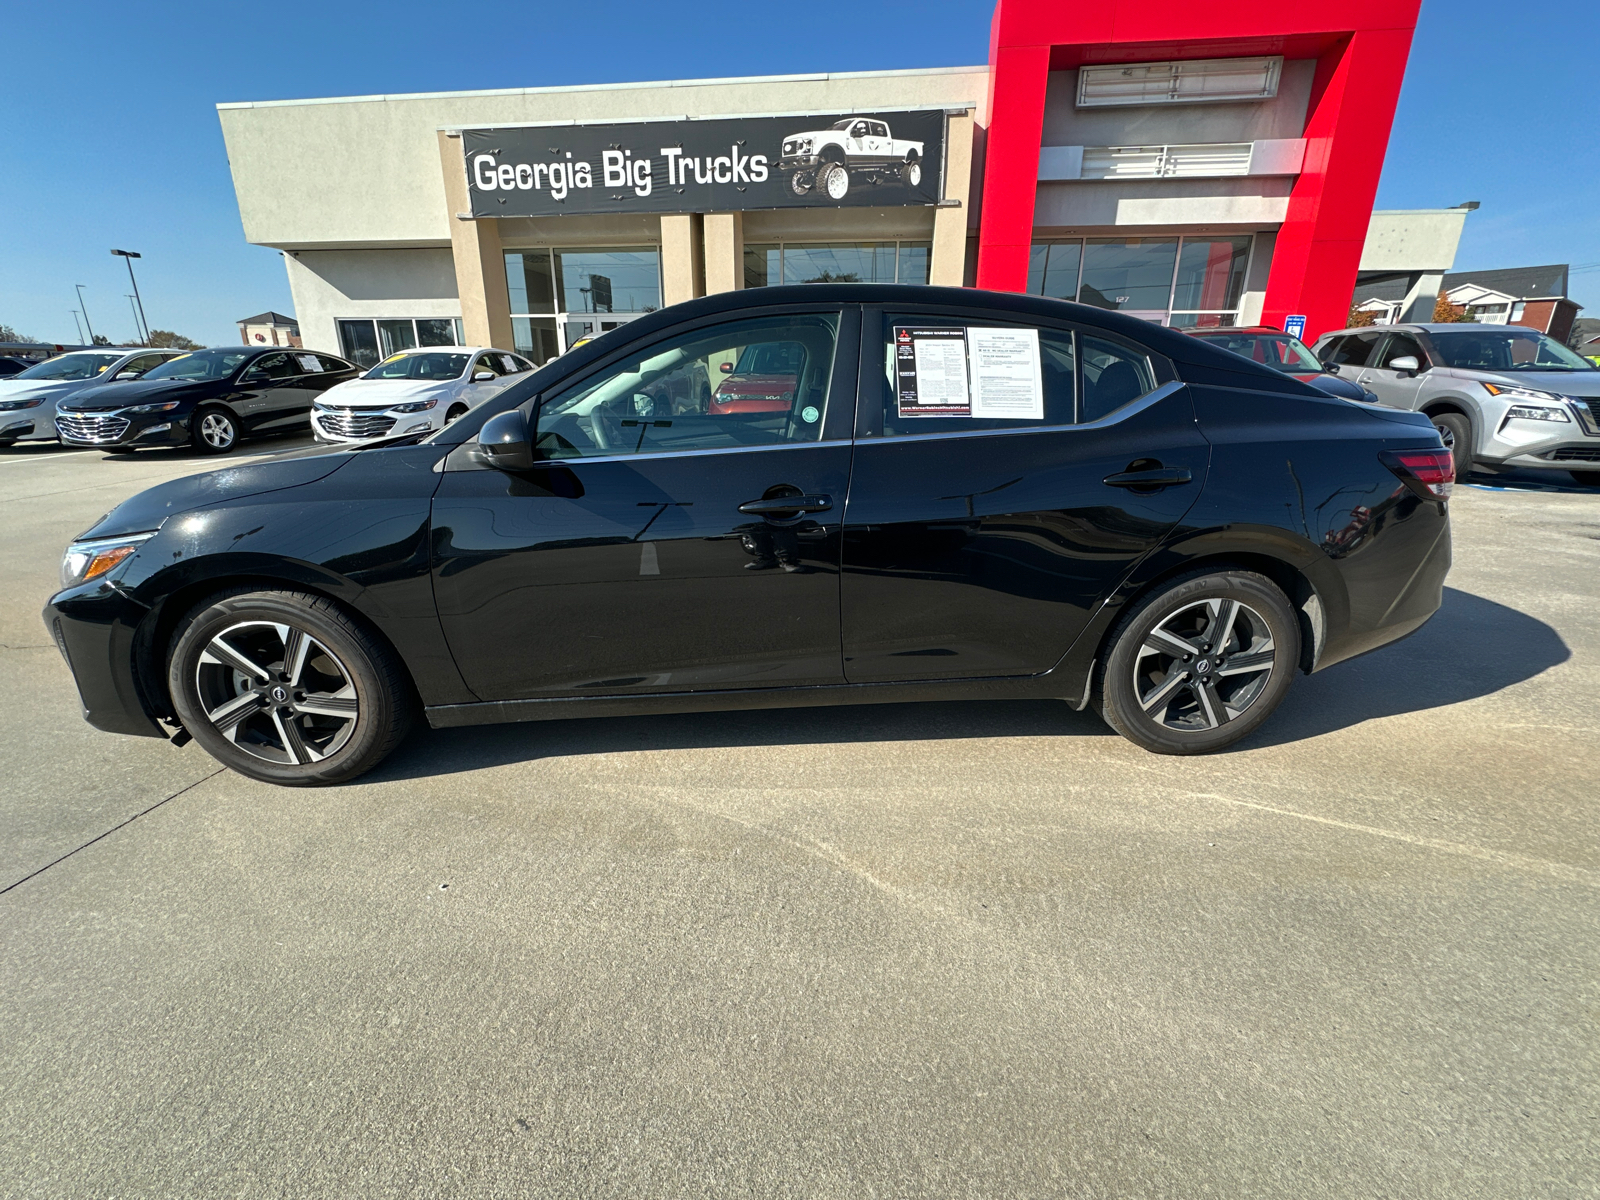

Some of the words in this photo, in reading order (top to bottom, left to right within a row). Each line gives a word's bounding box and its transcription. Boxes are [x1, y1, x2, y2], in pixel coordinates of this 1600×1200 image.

[473, 152, 593, 200] Georgia
[602, 150, 652, 197] Big
[660, 145, 769, 185] Trucks
